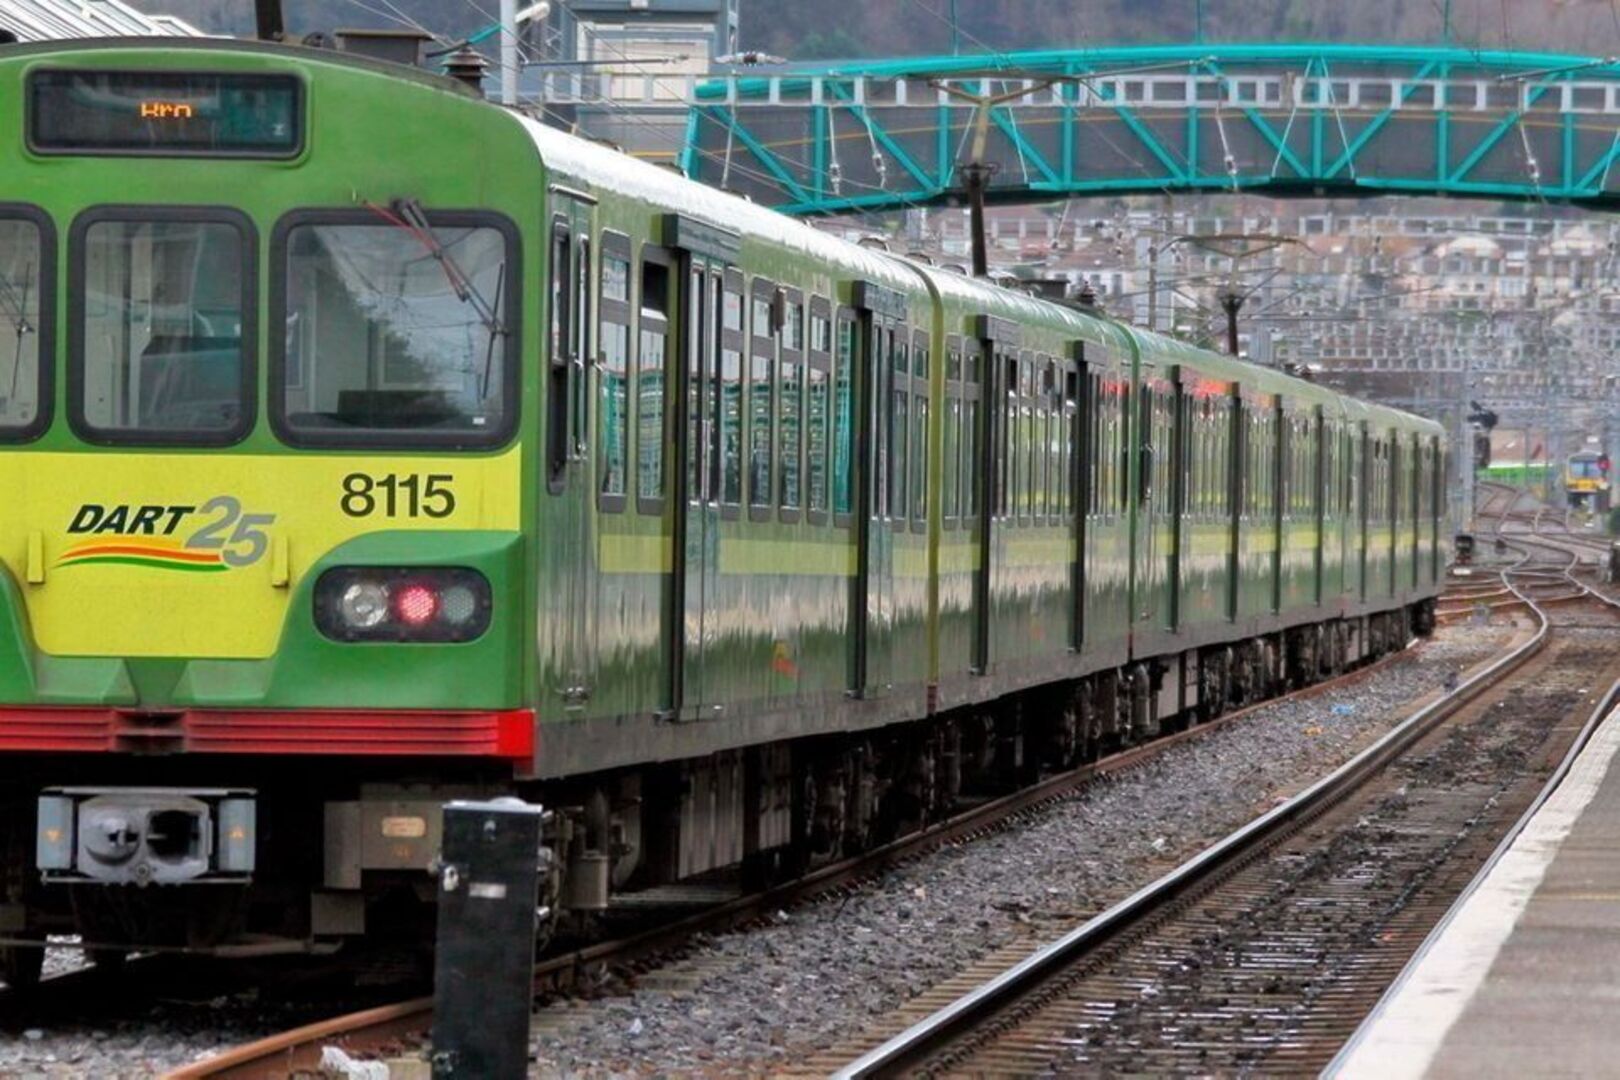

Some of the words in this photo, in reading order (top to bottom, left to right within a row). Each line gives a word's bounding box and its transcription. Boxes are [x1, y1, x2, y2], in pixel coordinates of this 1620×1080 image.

[341, 472, 455, 518] 8115
[67, 504, 196, 535] DART
[185, 495, 276, 567] 25
